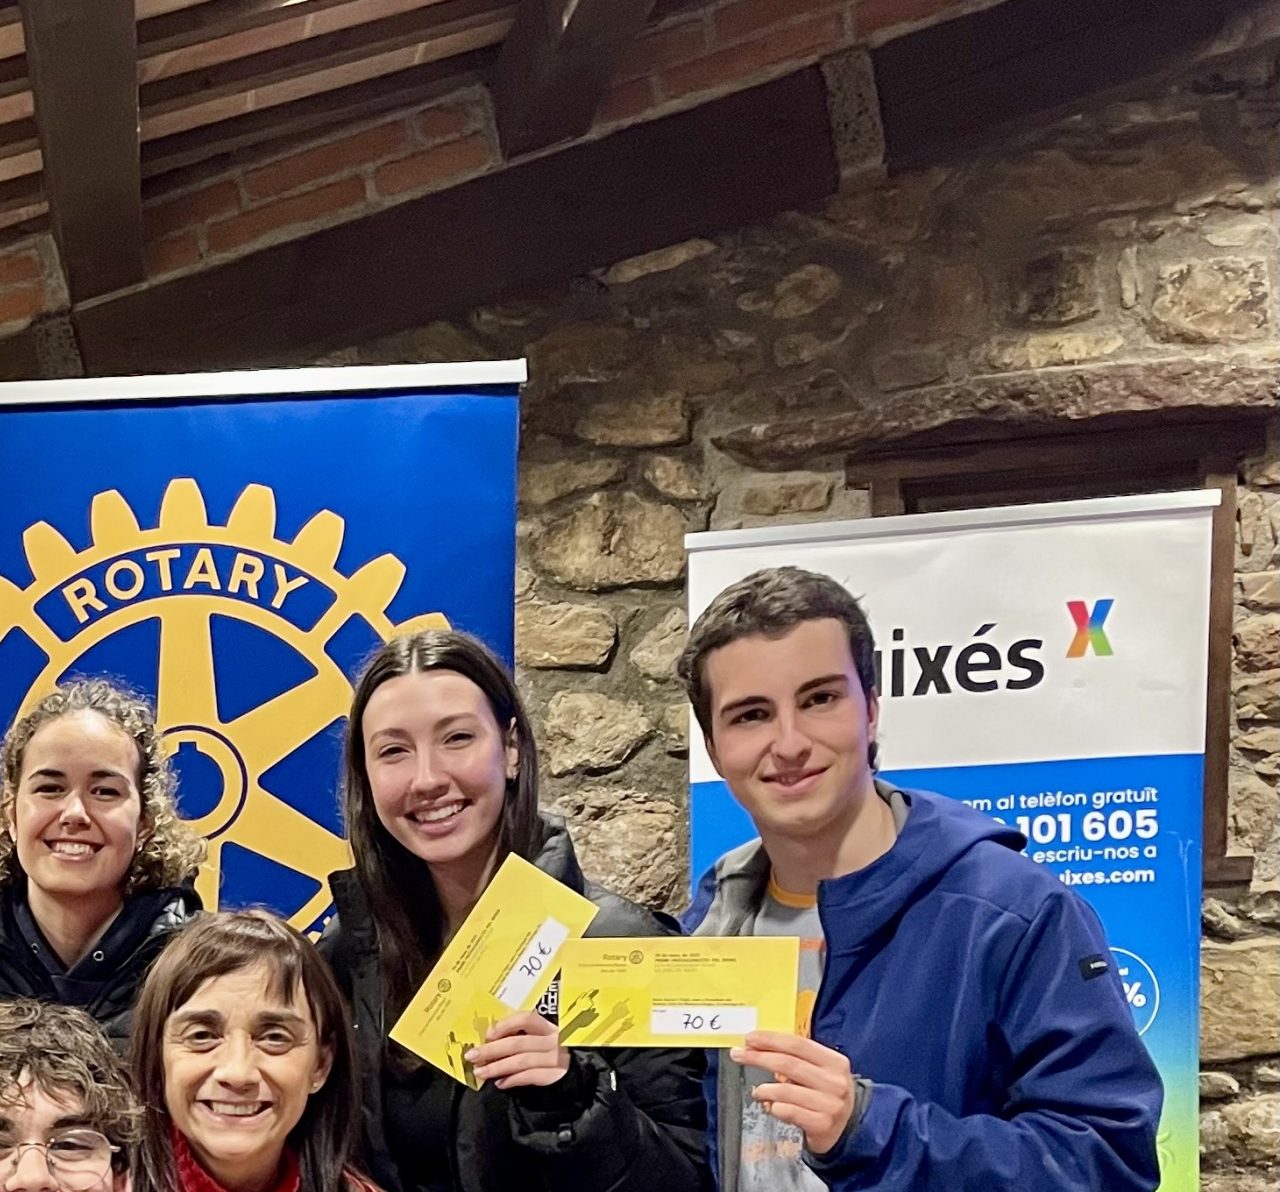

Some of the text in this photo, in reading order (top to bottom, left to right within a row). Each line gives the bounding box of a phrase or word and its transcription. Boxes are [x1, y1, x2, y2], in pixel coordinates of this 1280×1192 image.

[61, 547, 310, 624] ROTARY
[996, 795, 1015, 810] al
[1020, 792, 1087, 807] telèfon
[1092, 787, 1158, 809] gratuït
[1017, 809, 1158, 843] 101 605
[1033, 846, 1139, 864] escriu-nos
[1143, 846, 1157, 858] a
[519, 942, 552, 977] 70 €
[682, 1013, 723, 1031] 70 €
